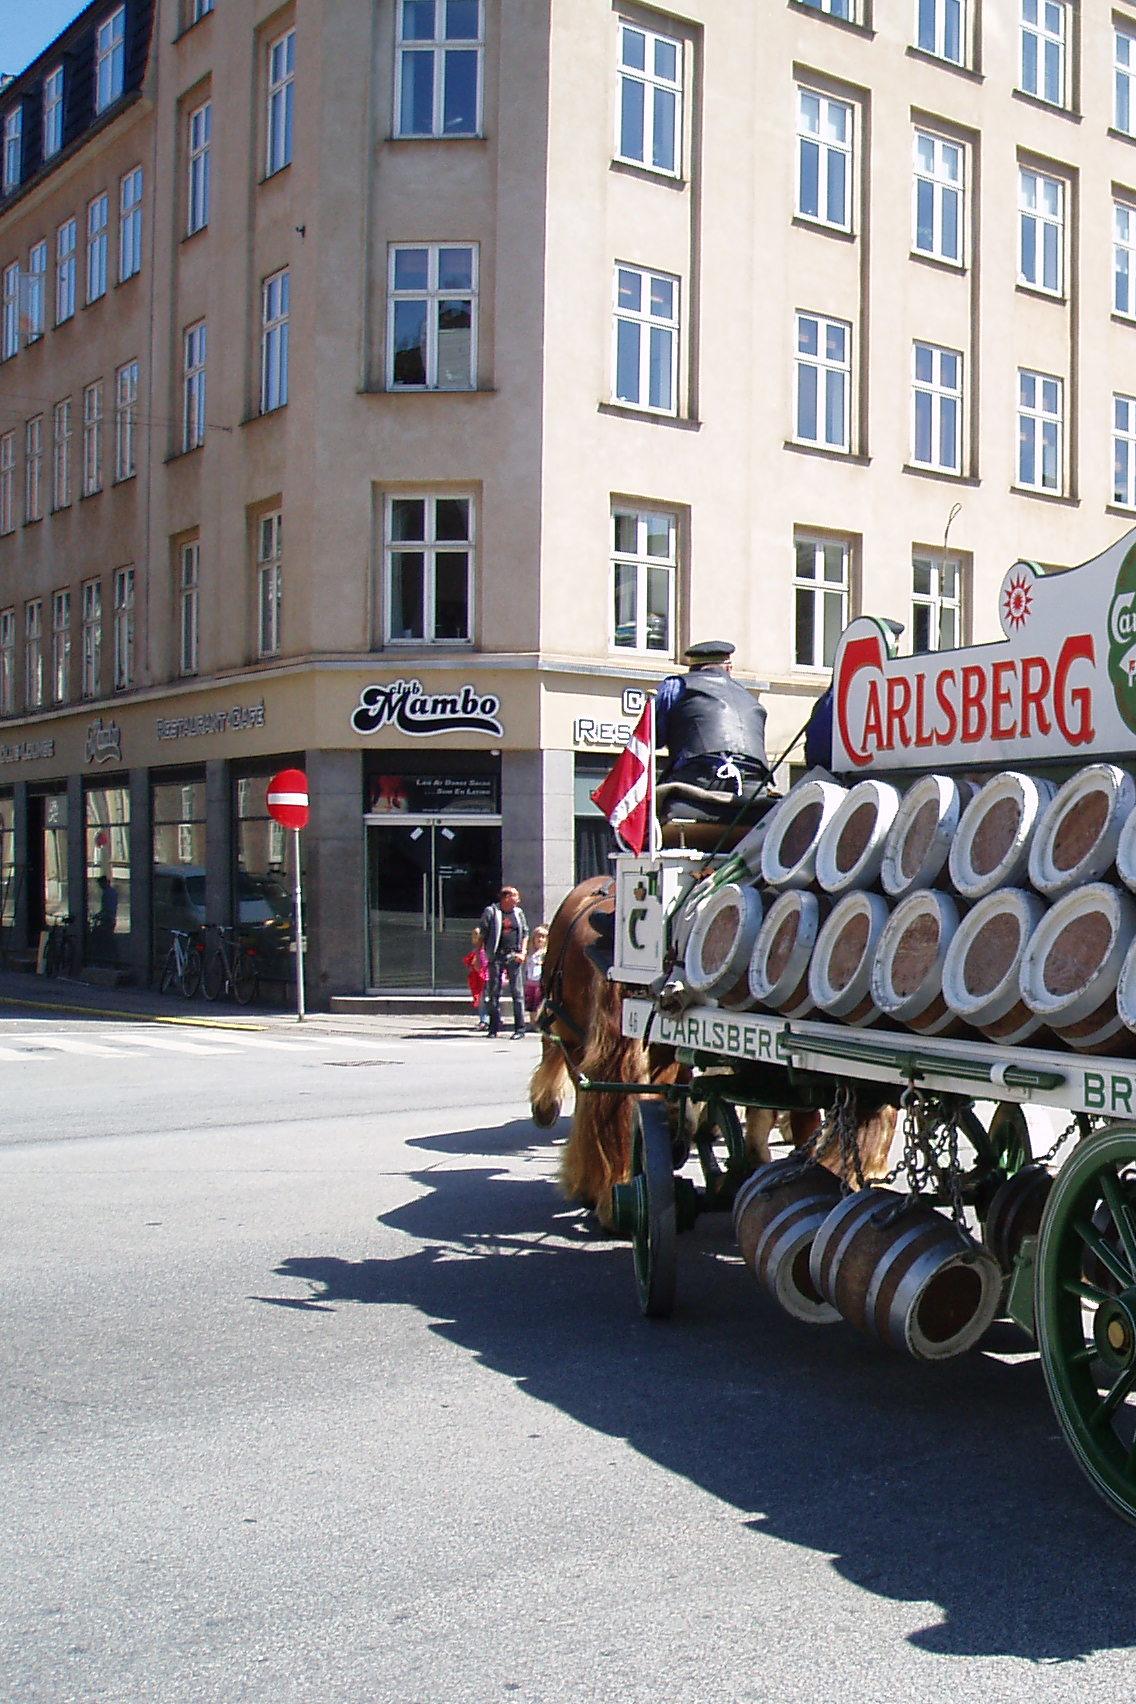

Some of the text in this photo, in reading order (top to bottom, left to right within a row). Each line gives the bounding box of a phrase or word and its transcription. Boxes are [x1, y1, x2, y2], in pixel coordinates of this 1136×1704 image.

[352, 685, 503, 737] Mambo
[388, 680, 422, 697] club
[838, 633, 1096, 767] CARLSBERG
